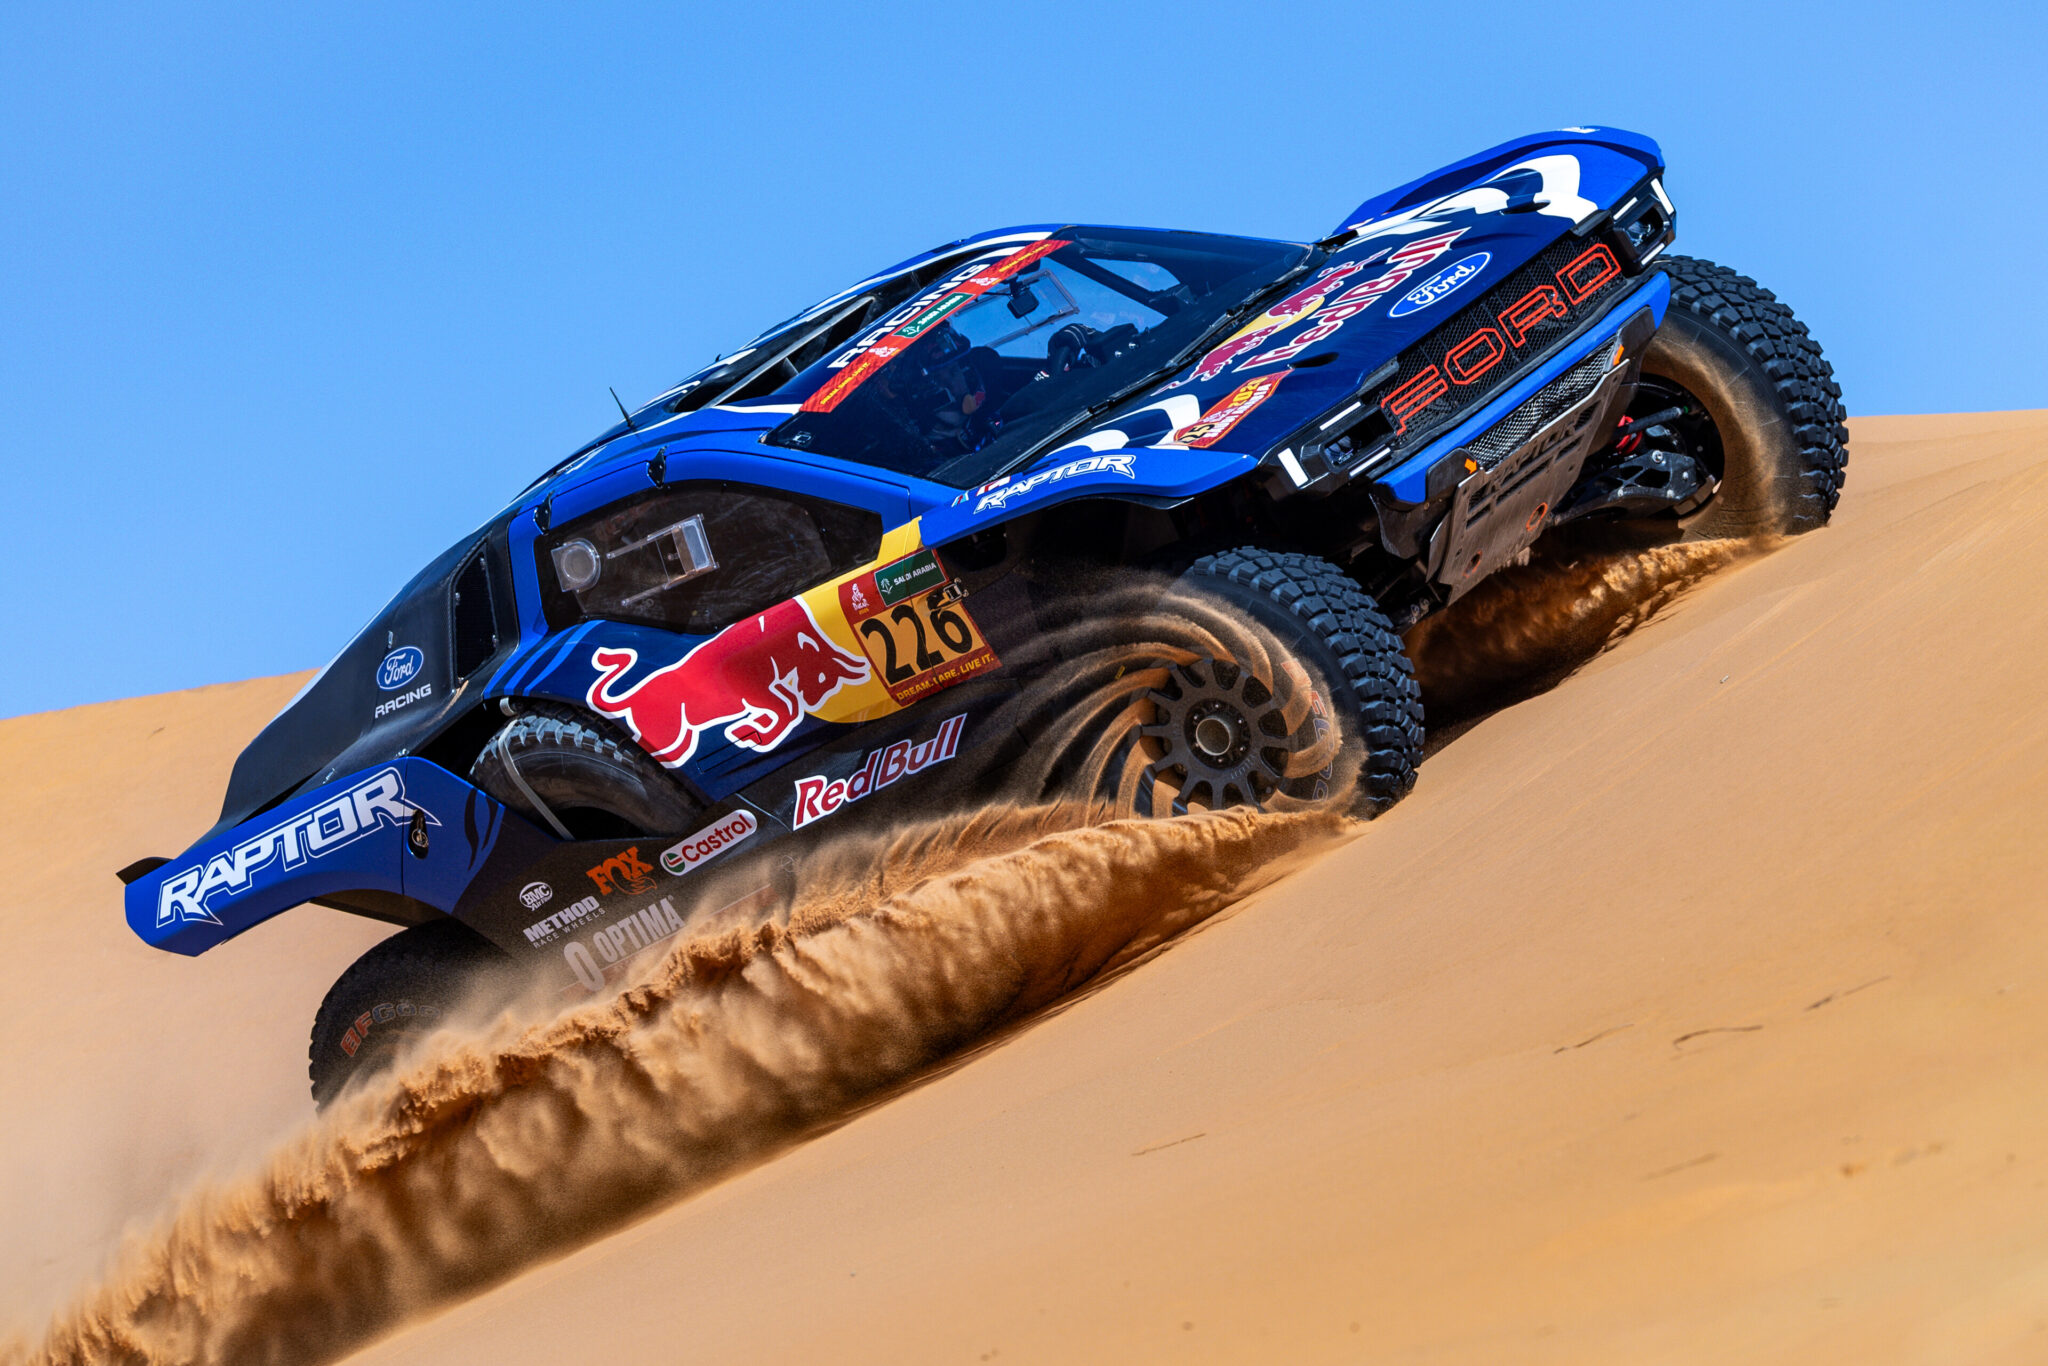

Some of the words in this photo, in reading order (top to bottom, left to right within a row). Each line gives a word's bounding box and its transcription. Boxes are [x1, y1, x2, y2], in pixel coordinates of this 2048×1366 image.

[1407, 263, 1476, 305] Ford
[827, 263, 991, 369] RACING
[1380, 243, 1621, 436] FORD
[973, 454, 1136, 514] RAPTOR
[912, 562, 938, 577] ARABIA
[859, 589, 973, 686] 226
[384, 652, 414, 685] Ford
[960, 658, 982, 674] LIVE
[375, 683, 432, 719] RACING
[156, 767, 442, 928] RAPTOR
[681, 813, 753, 862] Castrol
[586, 846, 656, 896] FOX
[522, 884, 550, 906] BMC
[523, 895, 600, 942] METHOD
[533, 932, 561, 949] RACE
[564, 907, 606, 934] WHEELS
